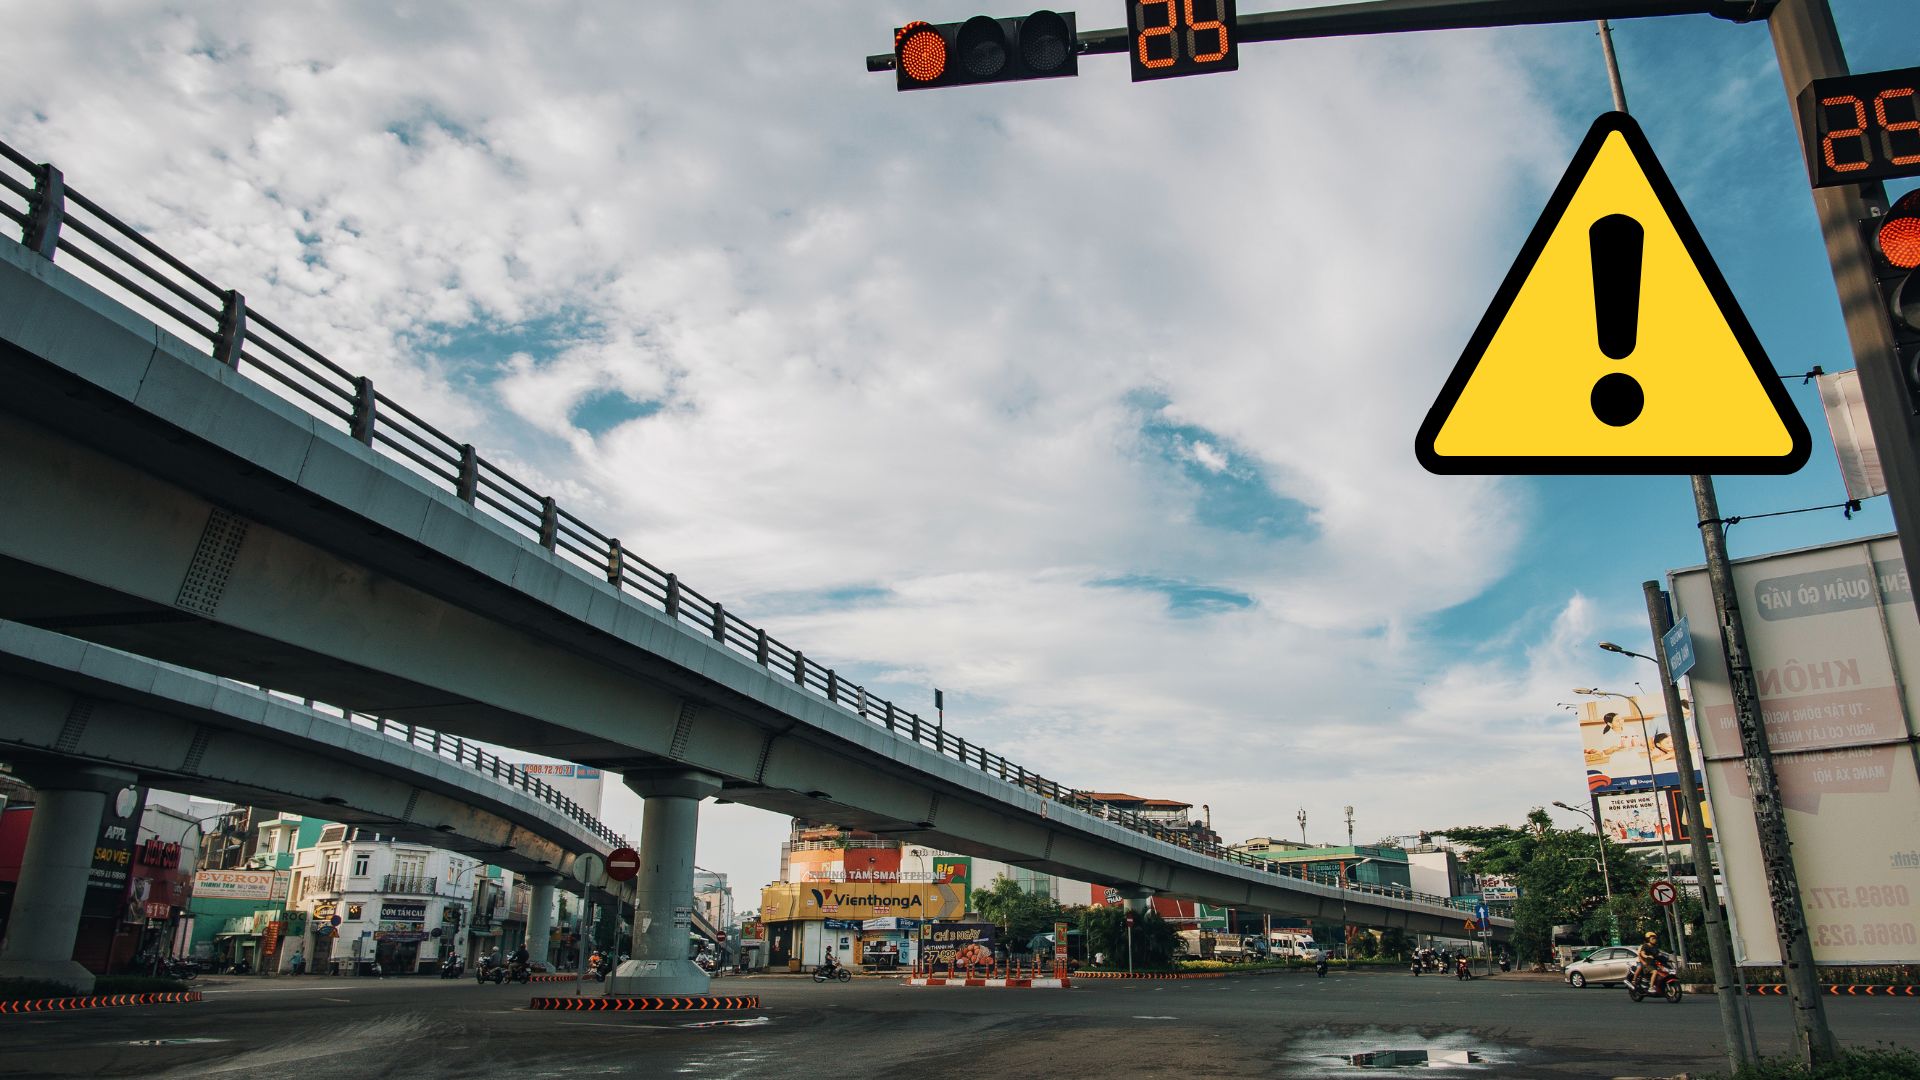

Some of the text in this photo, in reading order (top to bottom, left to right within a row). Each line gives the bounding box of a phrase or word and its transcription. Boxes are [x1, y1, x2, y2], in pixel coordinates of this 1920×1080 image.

[849, 869, 873, 880] TÂM
[873, 871, 947, 881] SMARTPHONE
[936, 863, 955, 878] Big
[197, 872, 271, 885] EVERON
[834, 893, 922, 909] VienthongA
